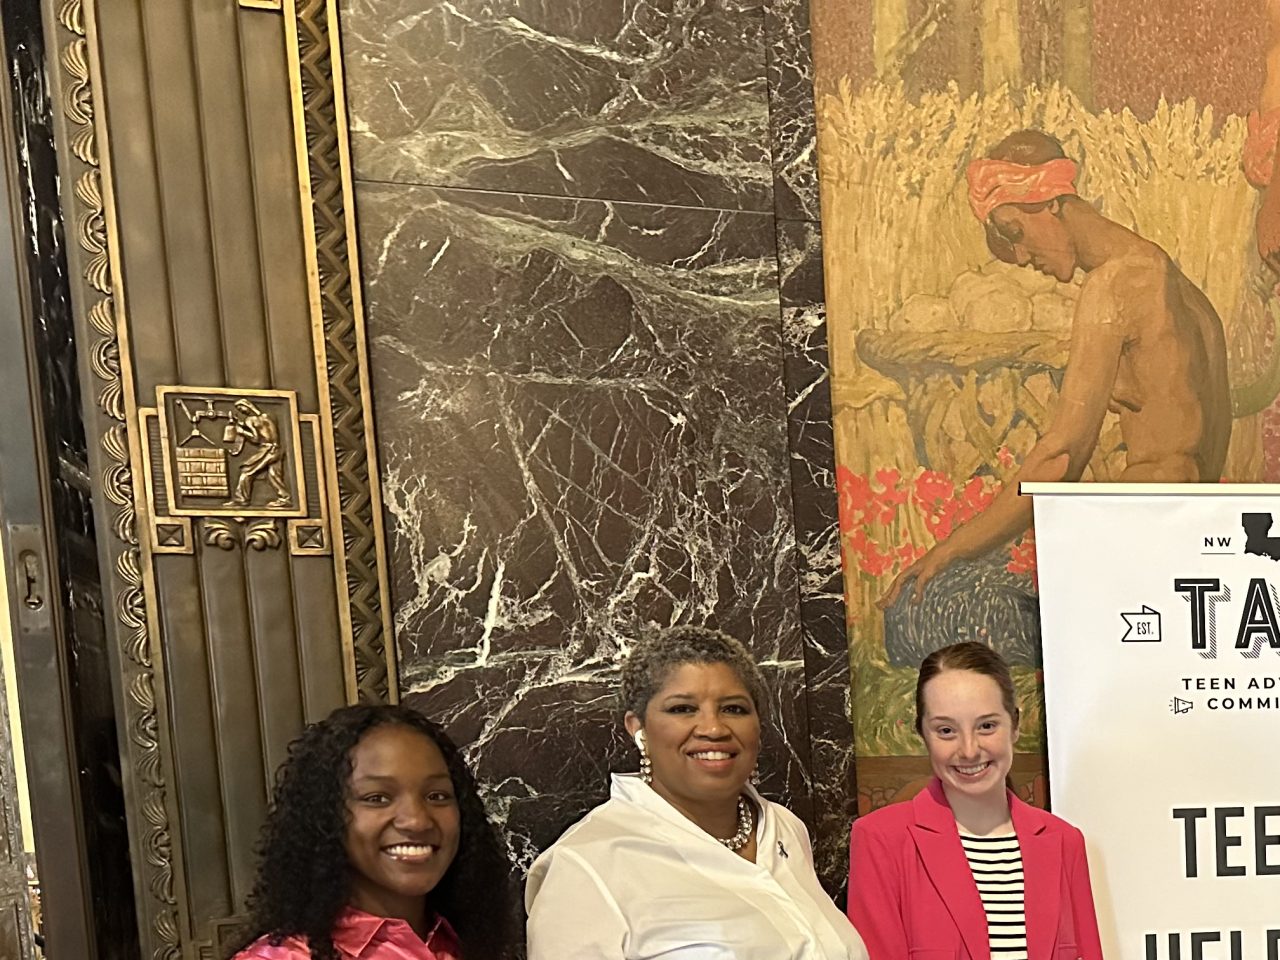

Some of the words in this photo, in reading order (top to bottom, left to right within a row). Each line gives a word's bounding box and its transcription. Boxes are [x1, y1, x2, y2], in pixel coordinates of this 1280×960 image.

[1204, 537, 1231, 547] NW
[1136, 621, 1154, 635] EST.
[1182, 677, 1237, 690] TEEN
